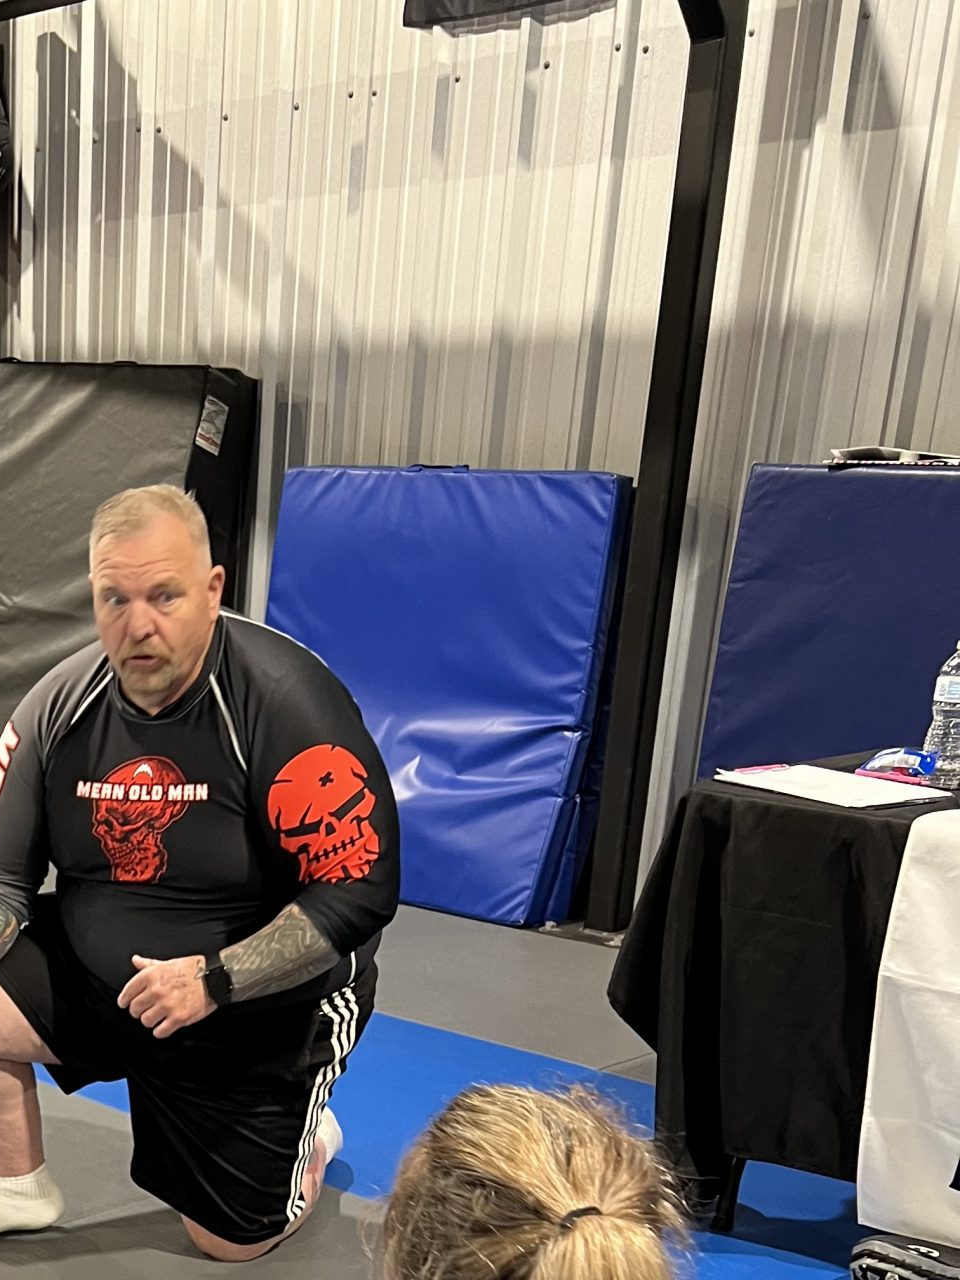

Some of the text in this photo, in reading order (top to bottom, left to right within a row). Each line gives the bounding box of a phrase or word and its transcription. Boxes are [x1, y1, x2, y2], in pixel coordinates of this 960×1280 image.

[76, 780, 209, 801] MEAN OLD MAN
